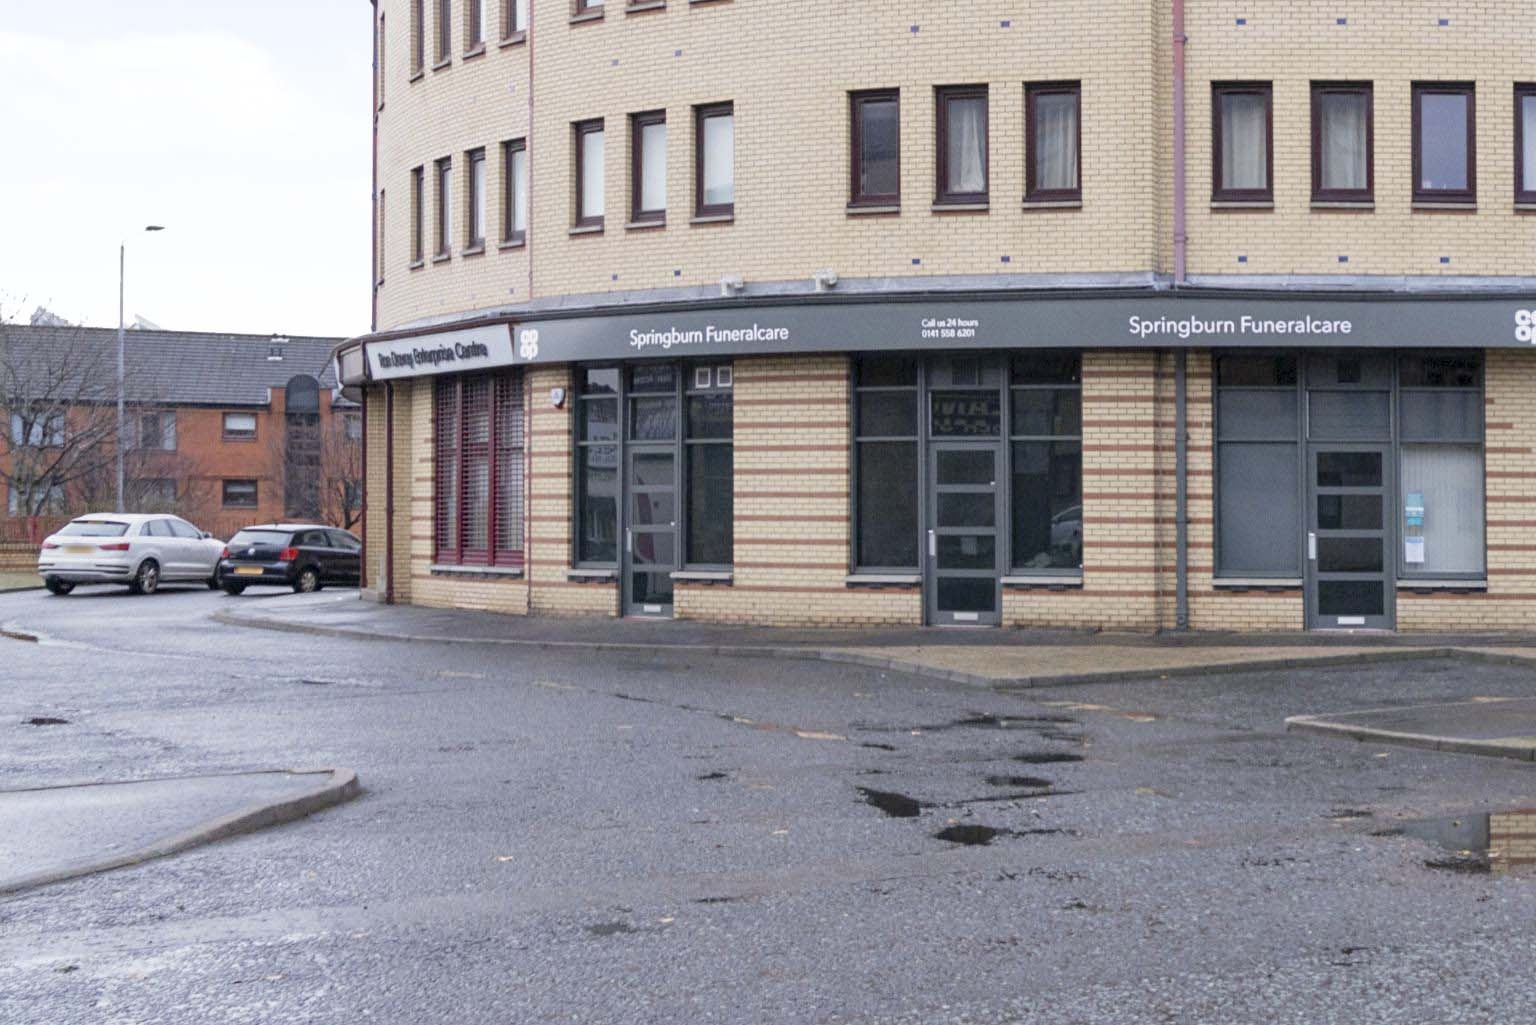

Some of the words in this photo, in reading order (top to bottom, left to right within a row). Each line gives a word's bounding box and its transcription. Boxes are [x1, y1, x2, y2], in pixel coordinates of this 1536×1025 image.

[921, 318, 936, 327] Call
[946, 317, 957, 327] 24
[957, 317, 979, 327] hours
[921, 328, 939, 338] 0141
[1129, 315, 1235, 338] Springburn
[1240, 315, 1352, 334] Funeralcare
[630, 326, 703, 349] Springburn
[705, 323, 789, 343] Funeralcare
[413, 343, 455, 366] Enterprise
[455, 341, 488, 360] Centre
